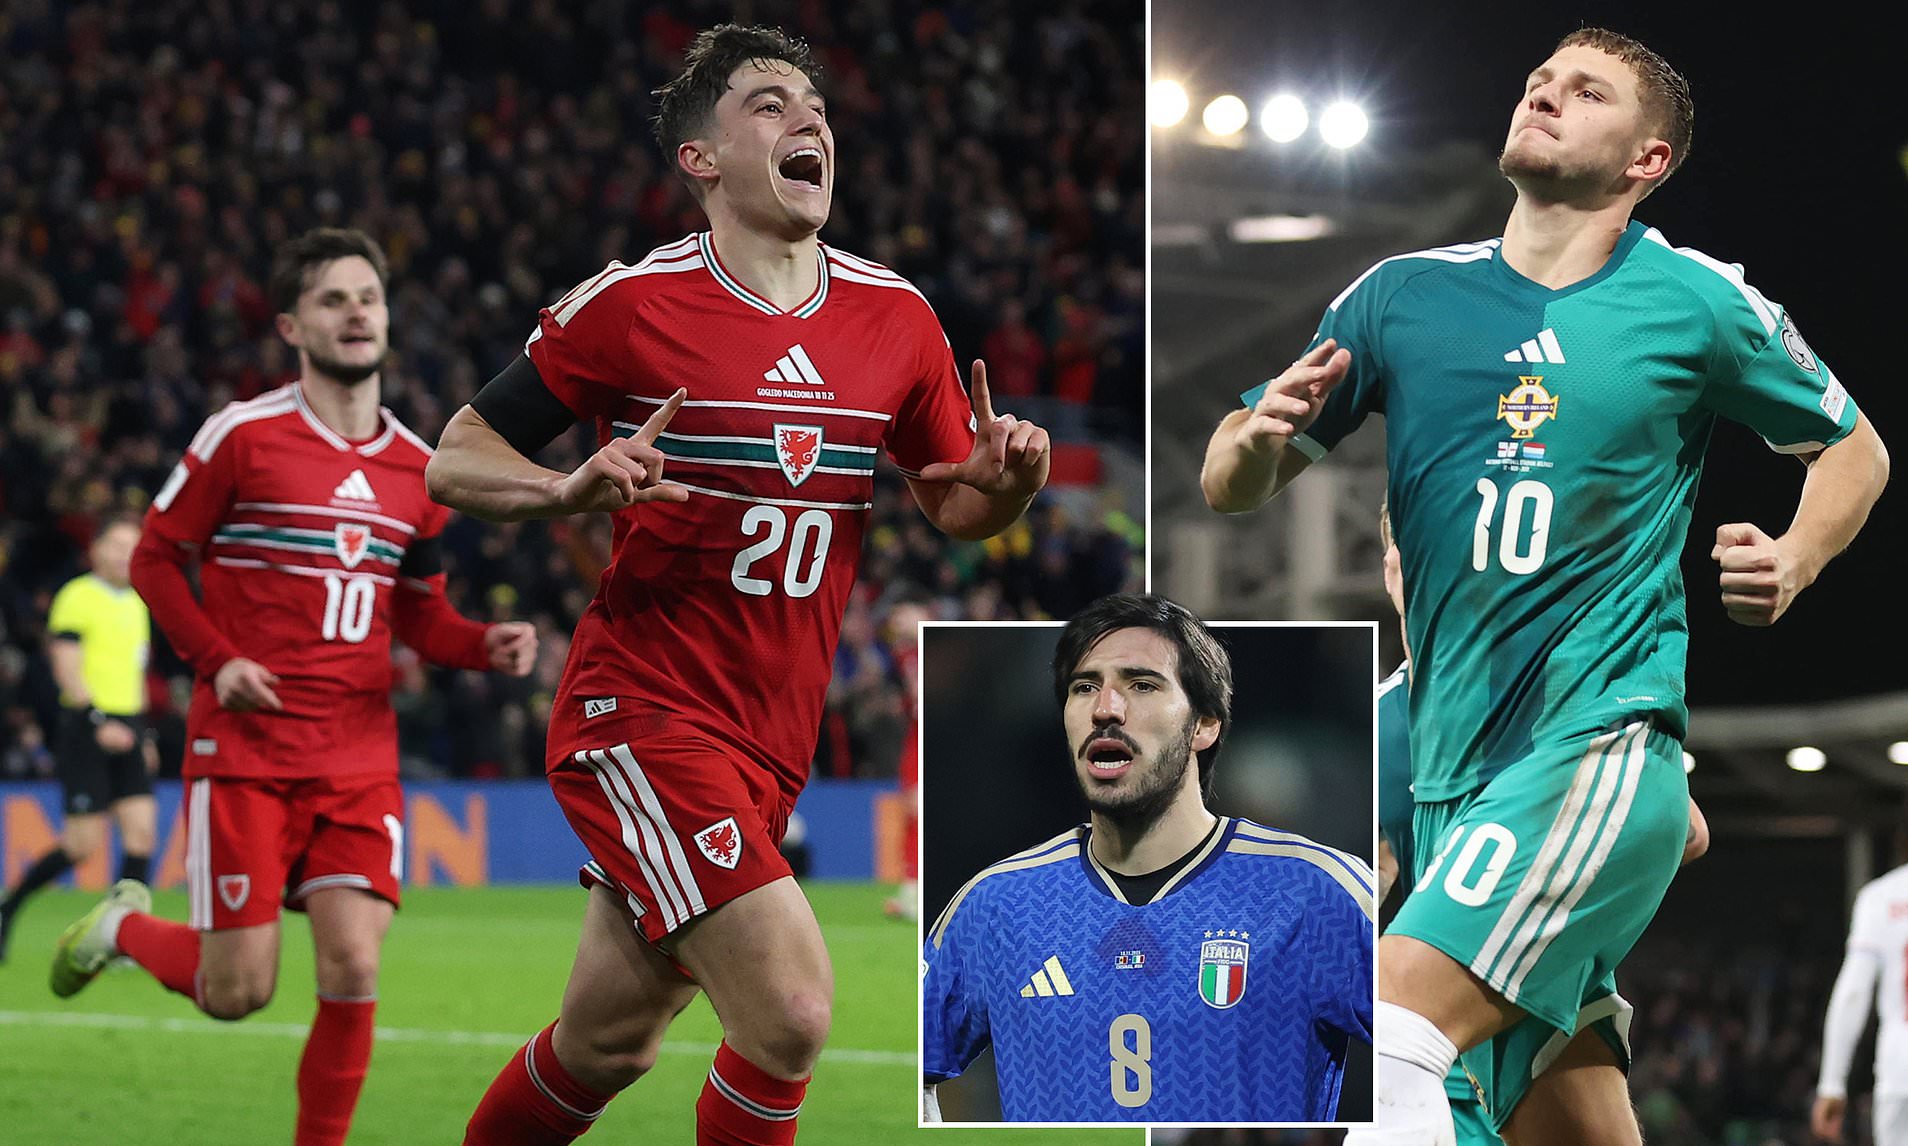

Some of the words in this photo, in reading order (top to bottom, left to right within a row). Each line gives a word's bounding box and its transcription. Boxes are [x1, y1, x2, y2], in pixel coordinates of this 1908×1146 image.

[783, 389, 814, 399] MACEDONIA
[827, 392, 835, 400] 25
[731, 504, 833, 598] 20
[1472, 477, 1554, 575] 10
[322, 572, 376, 643] 10
[1204, 945, 1245, 961] ITALIA
[1109, 1013, 1152, 1108] 8
